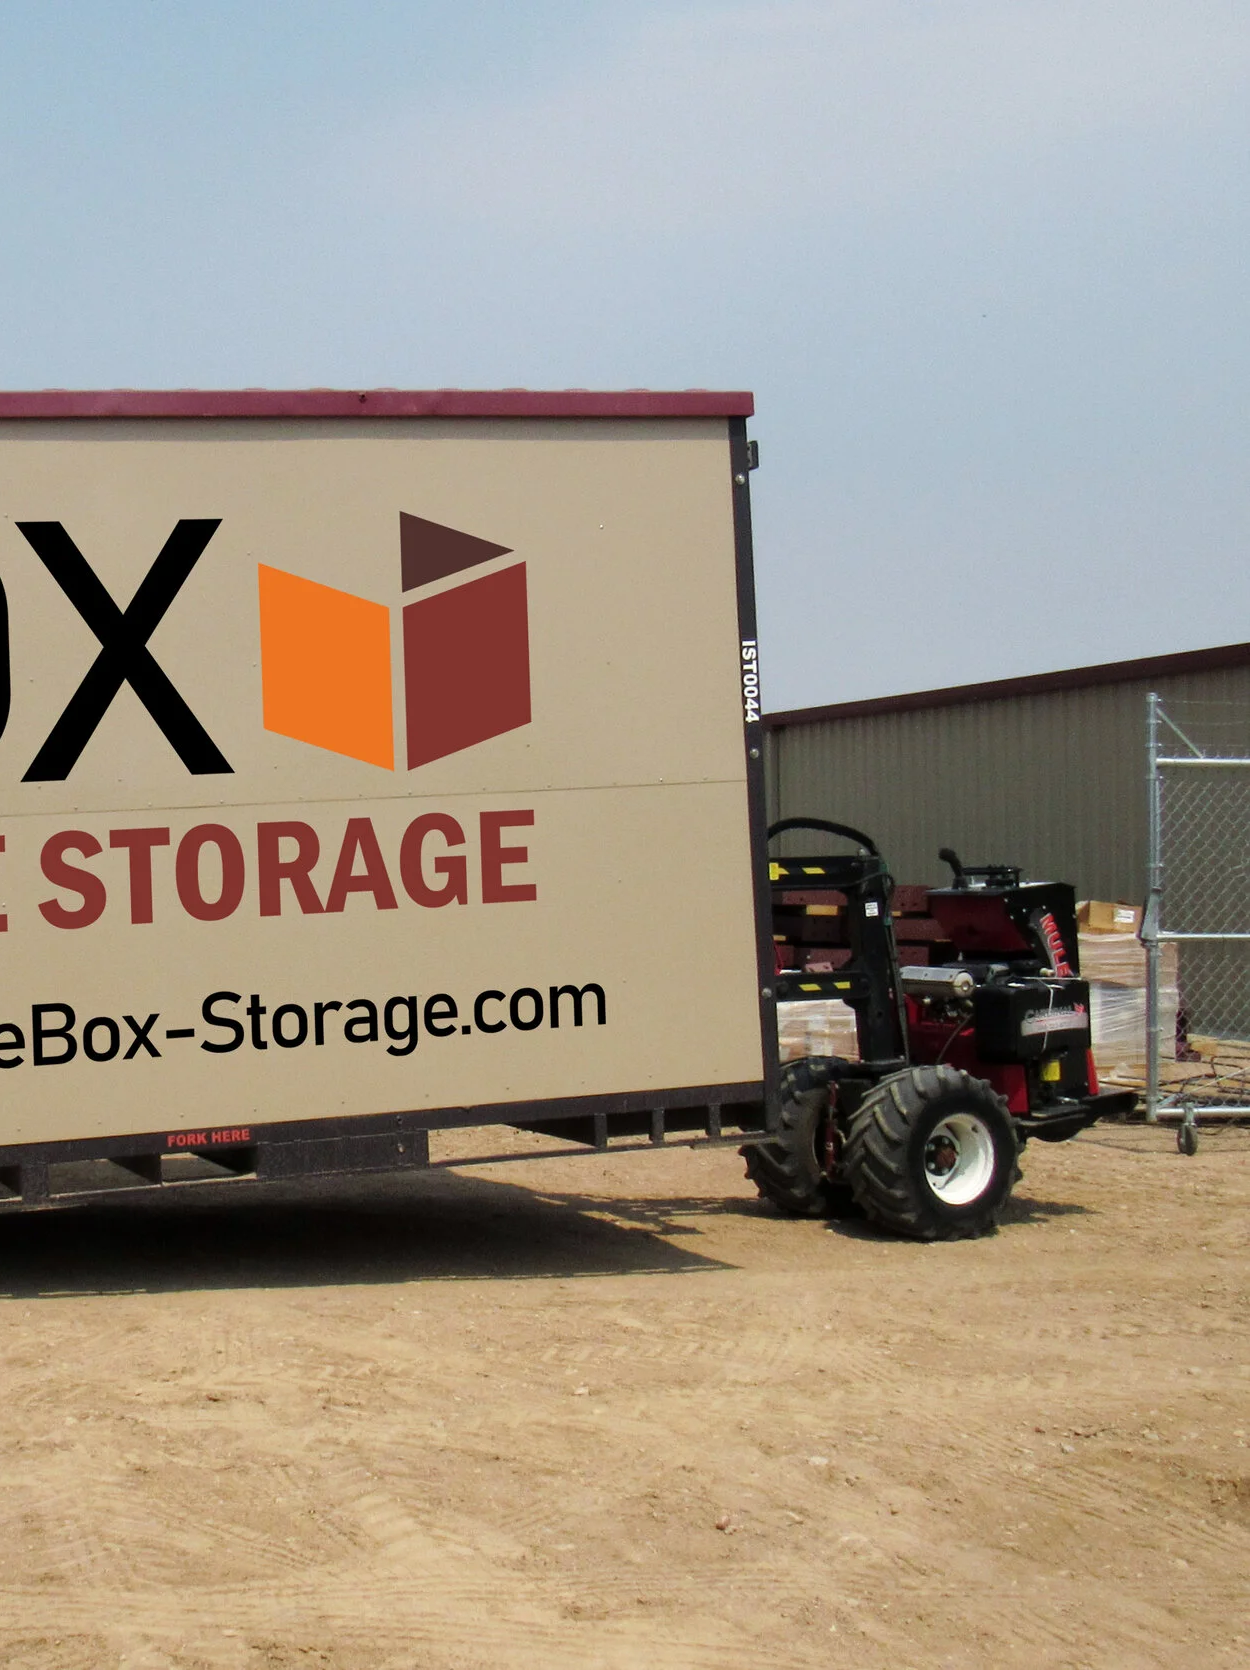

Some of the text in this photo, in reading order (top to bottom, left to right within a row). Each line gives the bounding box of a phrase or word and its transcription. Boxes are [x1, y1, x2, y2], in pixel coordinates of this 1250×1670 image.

[742, 640, 760, 722] IST0044
[39, 810, 536, 929] STORAGE
[1040, 913, 1072, 977] MULE
[167, 1129, 250, 1147] FORK HERE
